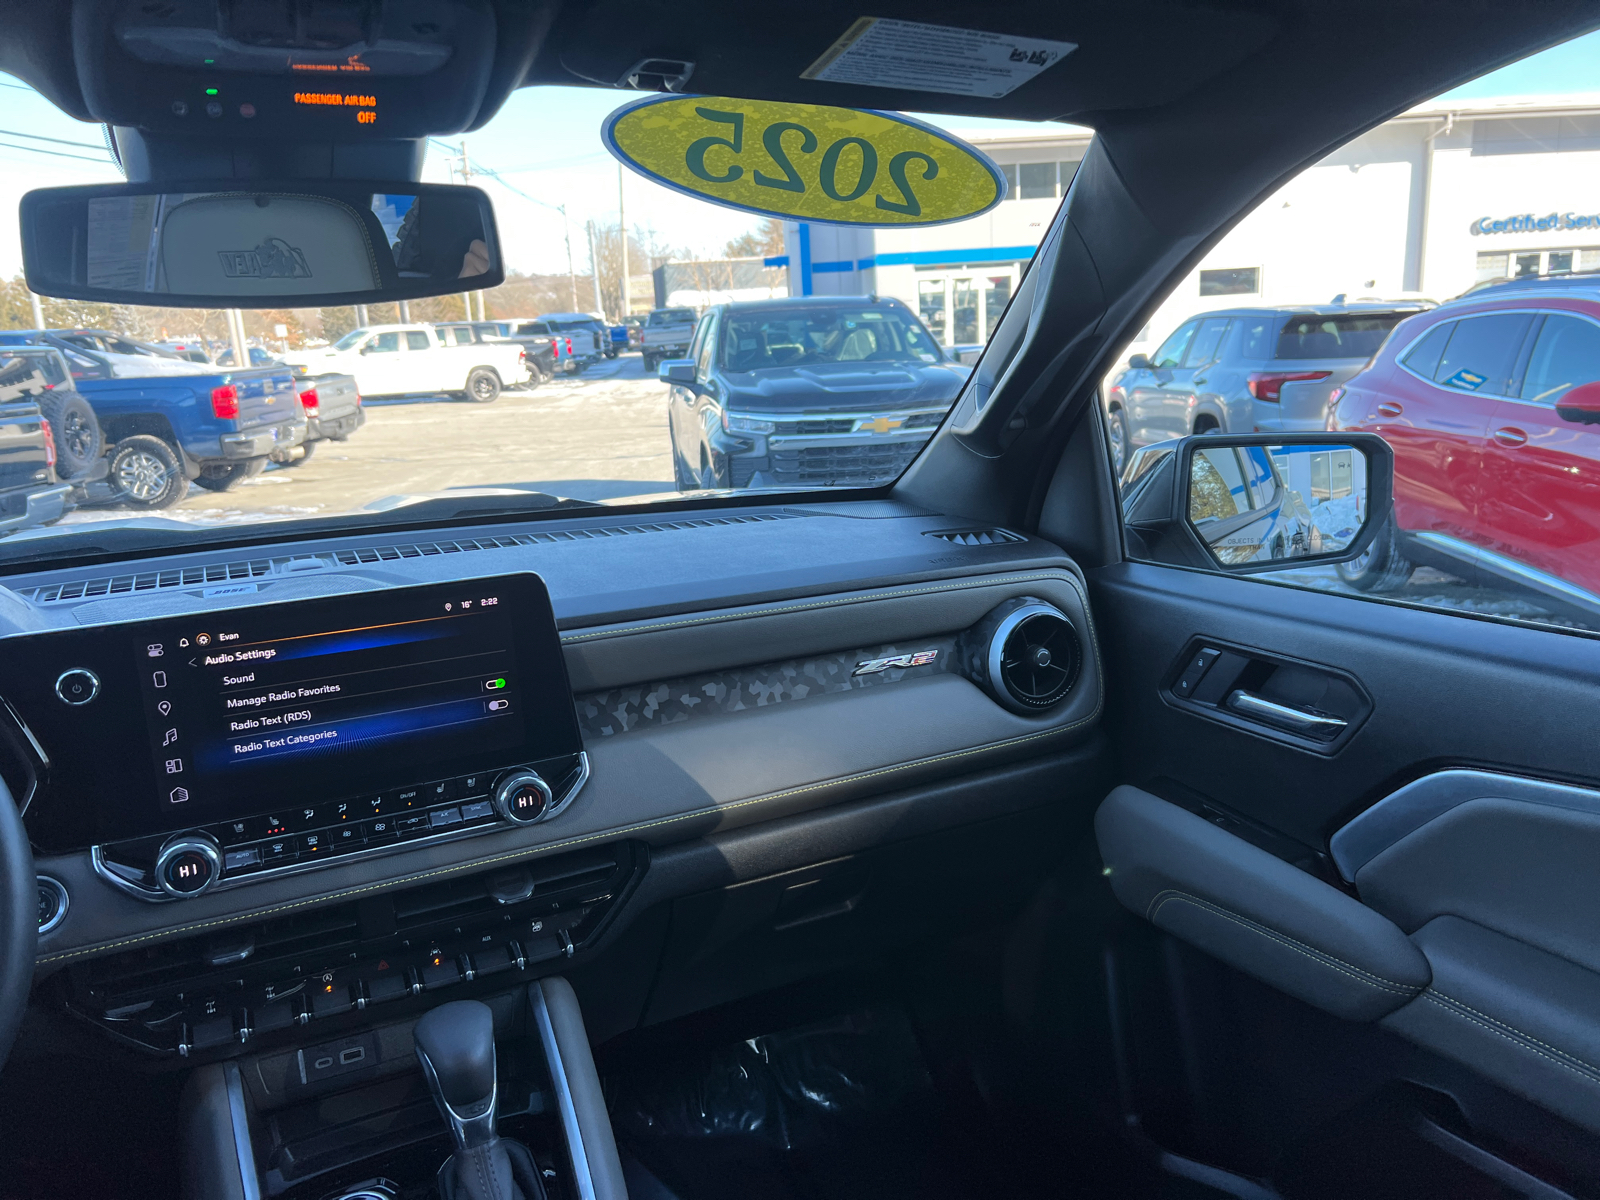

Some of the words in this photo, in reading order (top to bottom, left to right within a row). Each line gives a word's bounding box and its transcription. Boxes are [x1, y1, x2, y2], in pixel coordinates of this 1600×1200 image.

[294, 92, 343, 105] PASSENGER
[357, 111, 376, 124] OFF
[1479, 212, 1559, 233] Certified
[208, 586, 251, 595] BOSE
[480, 597, 498, 606] 2:22
[219, 633, 240, 642] Evan
[205, 654, 234, 666] Audio
[235, 648, 276, 659] Settings
[851, 649, 939, 678] ZR2
[223, 672, 255, 686] Sound
[227, 695, 266, 708] Manage
[268, 690, 297, 702] Radio
[298, 683, 341, 697] Favorites
[230, 719, 260, 731] Radio
[260, 716, 282, 726] Text
[283, 709, 312, 725] (RDS)
[234, 743, 263, 754] Radio
[263, 738, 286, 749] Text
[286, 730, 338, 745] Categories
[399, 791, 416, 800] ON/OFF
[518, 795, 533, 808] HI
[179, 863, 198, 879] HI
